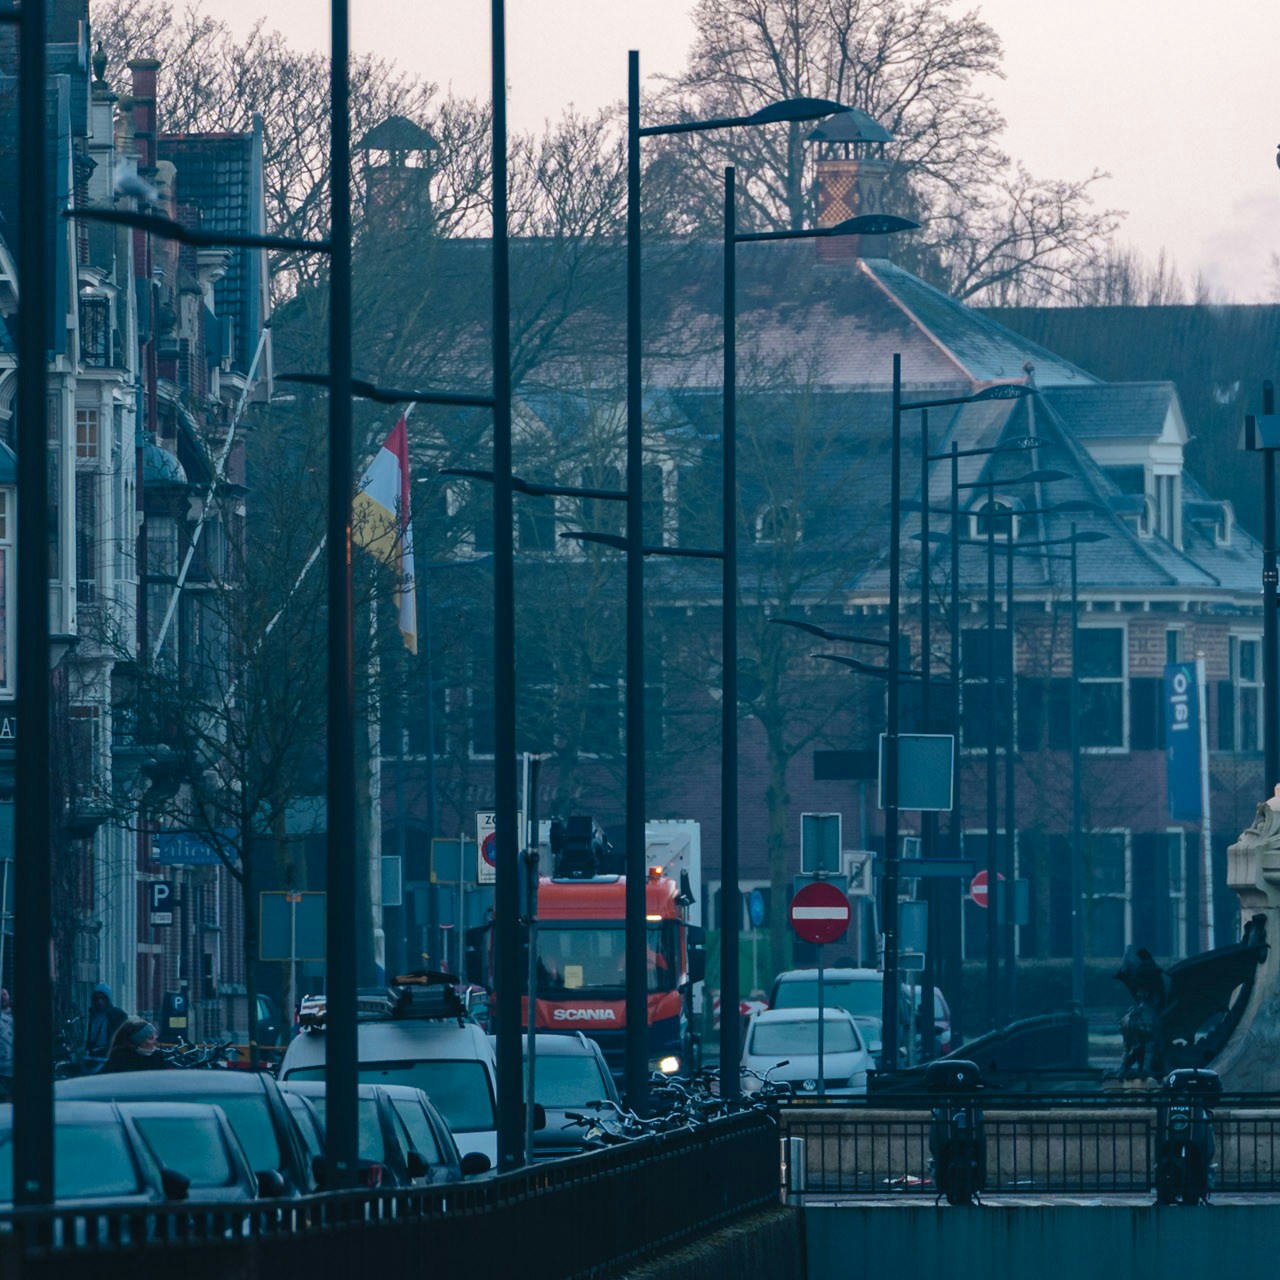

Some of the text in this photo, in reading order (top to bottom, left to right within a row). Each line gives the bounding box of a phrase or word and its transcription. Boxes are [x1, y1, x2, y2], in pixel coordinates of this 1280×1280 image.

[154, 884, 170, 907] P
[174, 996, 183, 1009] P
[553, 1008, 616, 1021] SCANIA
